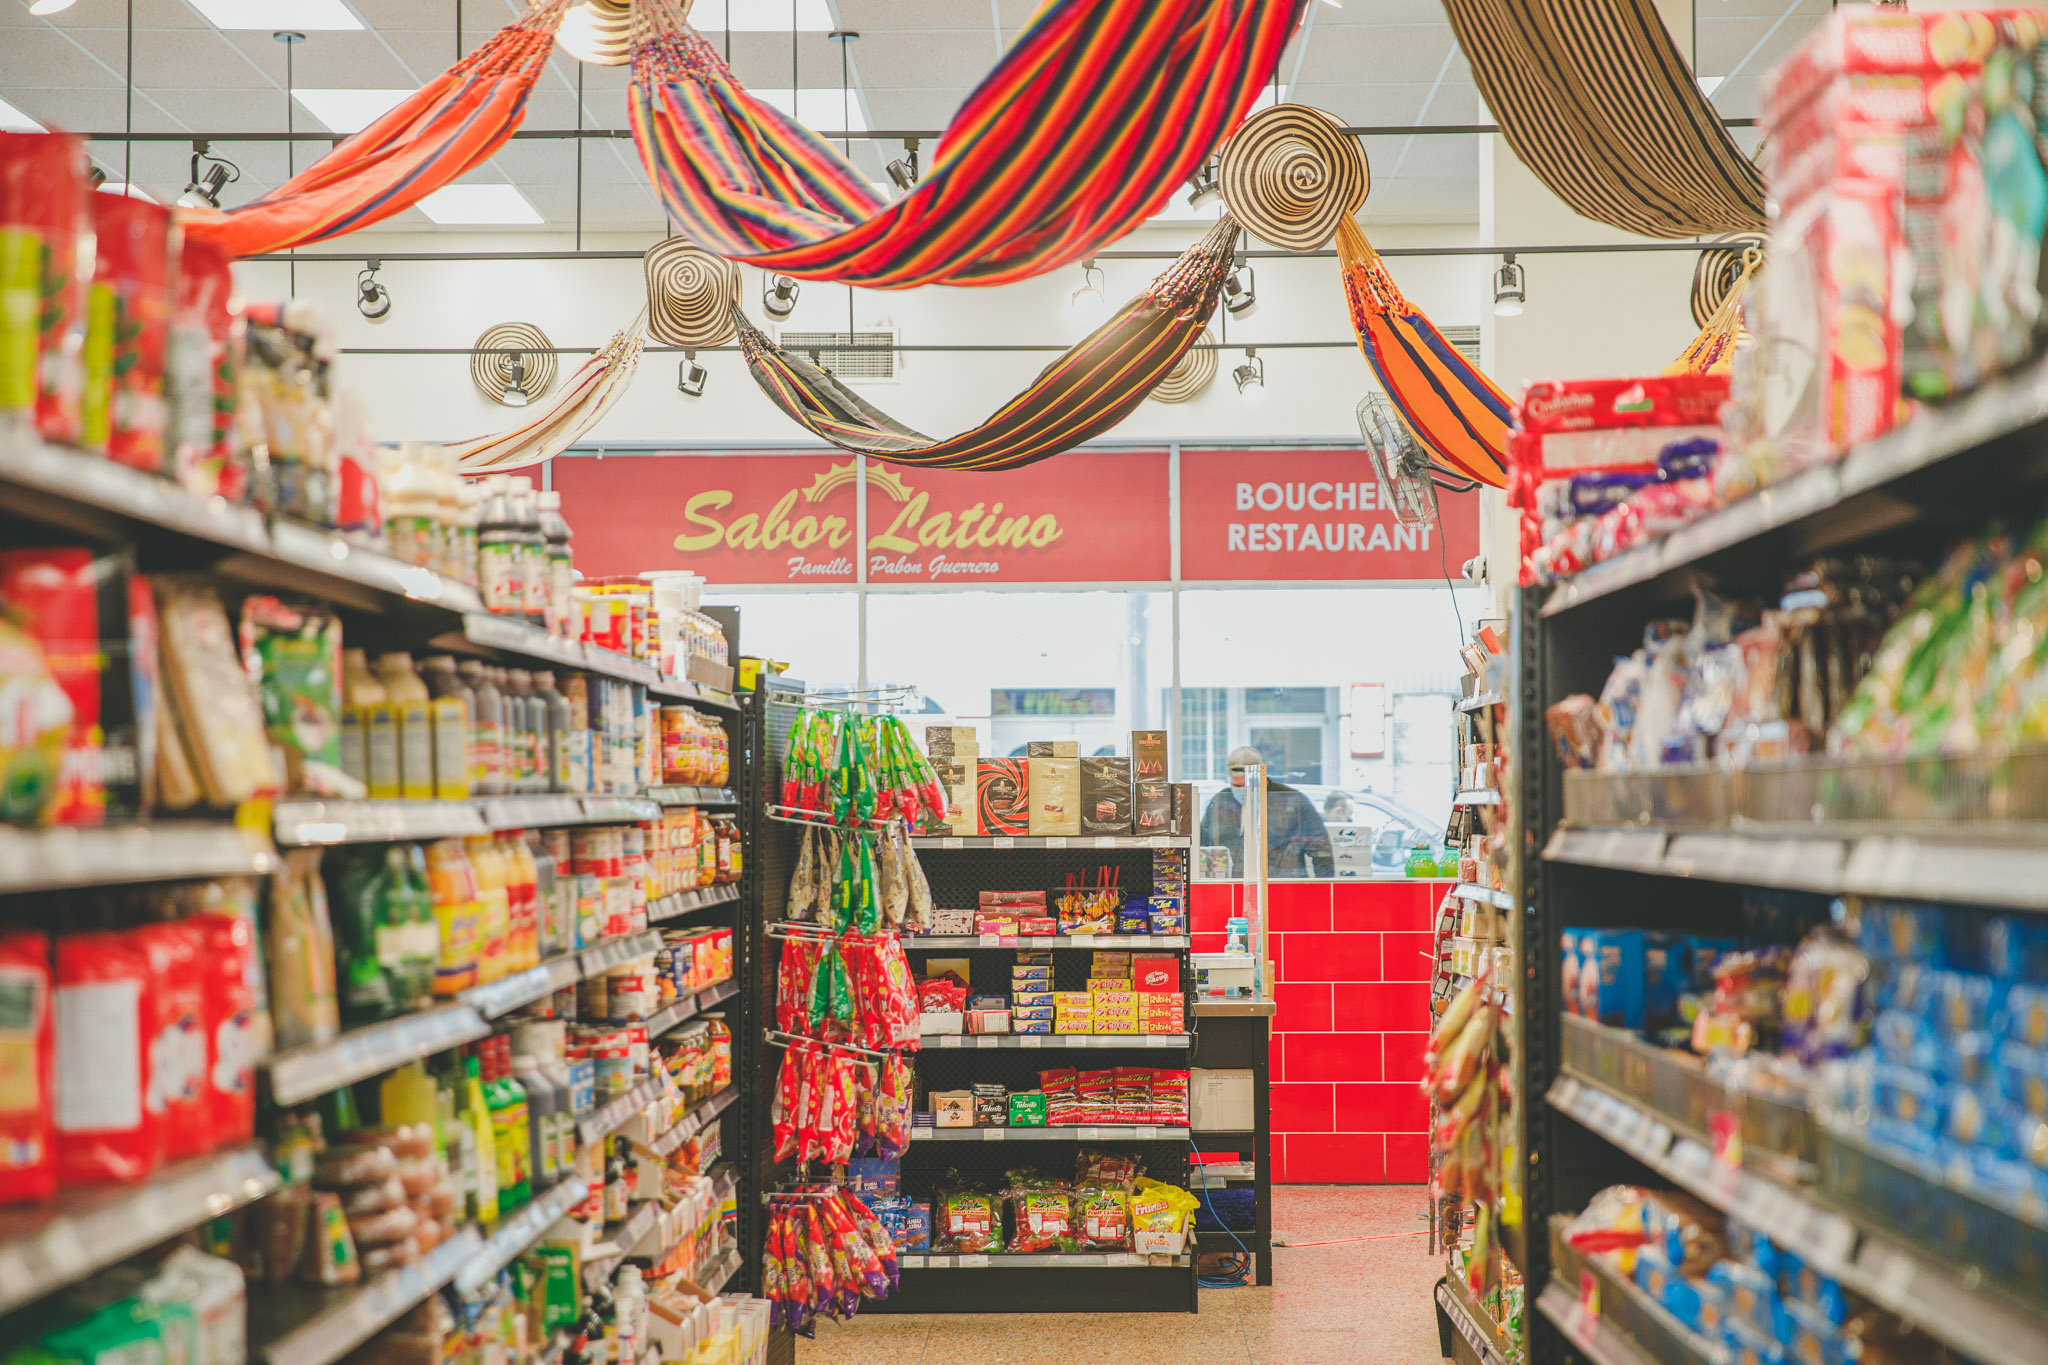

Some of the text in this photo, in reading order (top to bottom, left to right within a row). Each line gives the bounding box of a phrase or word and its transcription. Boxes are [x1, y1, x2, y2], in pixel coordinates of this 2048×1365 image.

[673, 488, 1063, 554] Sabor Latino
[1228, 523, 1434, 551] RESTAURANT
[787, 555, 999, 580] Famille Pabon Guerrero
